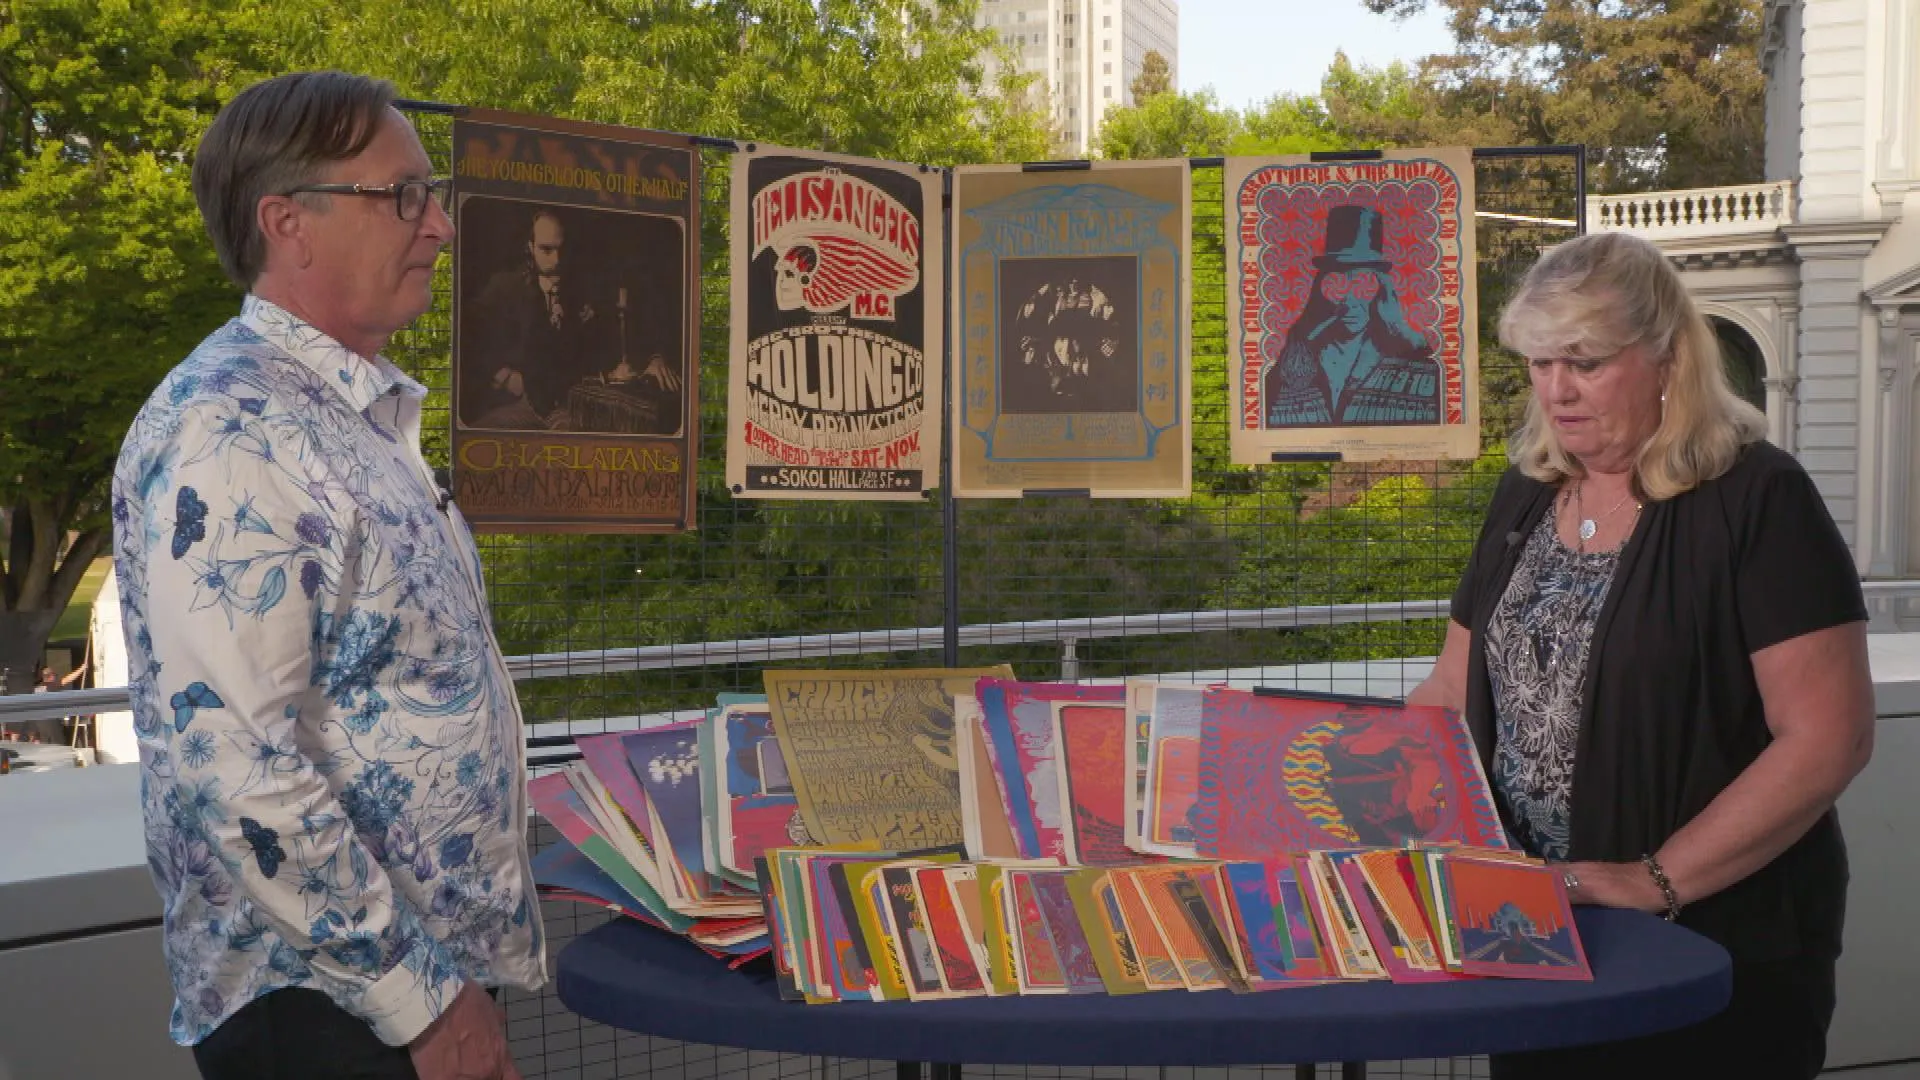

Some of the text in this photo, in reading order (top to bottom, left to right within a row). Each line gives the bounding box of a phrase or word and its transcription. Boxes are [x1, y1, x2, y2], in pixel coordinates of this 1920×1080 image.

[1336, 165, 1351, 183] &
[1351, 163, 1389, 183] THE
[855, 292, 893, 317] M.C.
[748, 335, 902, 411] HOLDING
[747, 386, 808, 446] MERRY
[781, 440, 809, 466] HEAD
[779, 469, 827, 488] SOKOL
[829, 469, 858, 489] HALL
